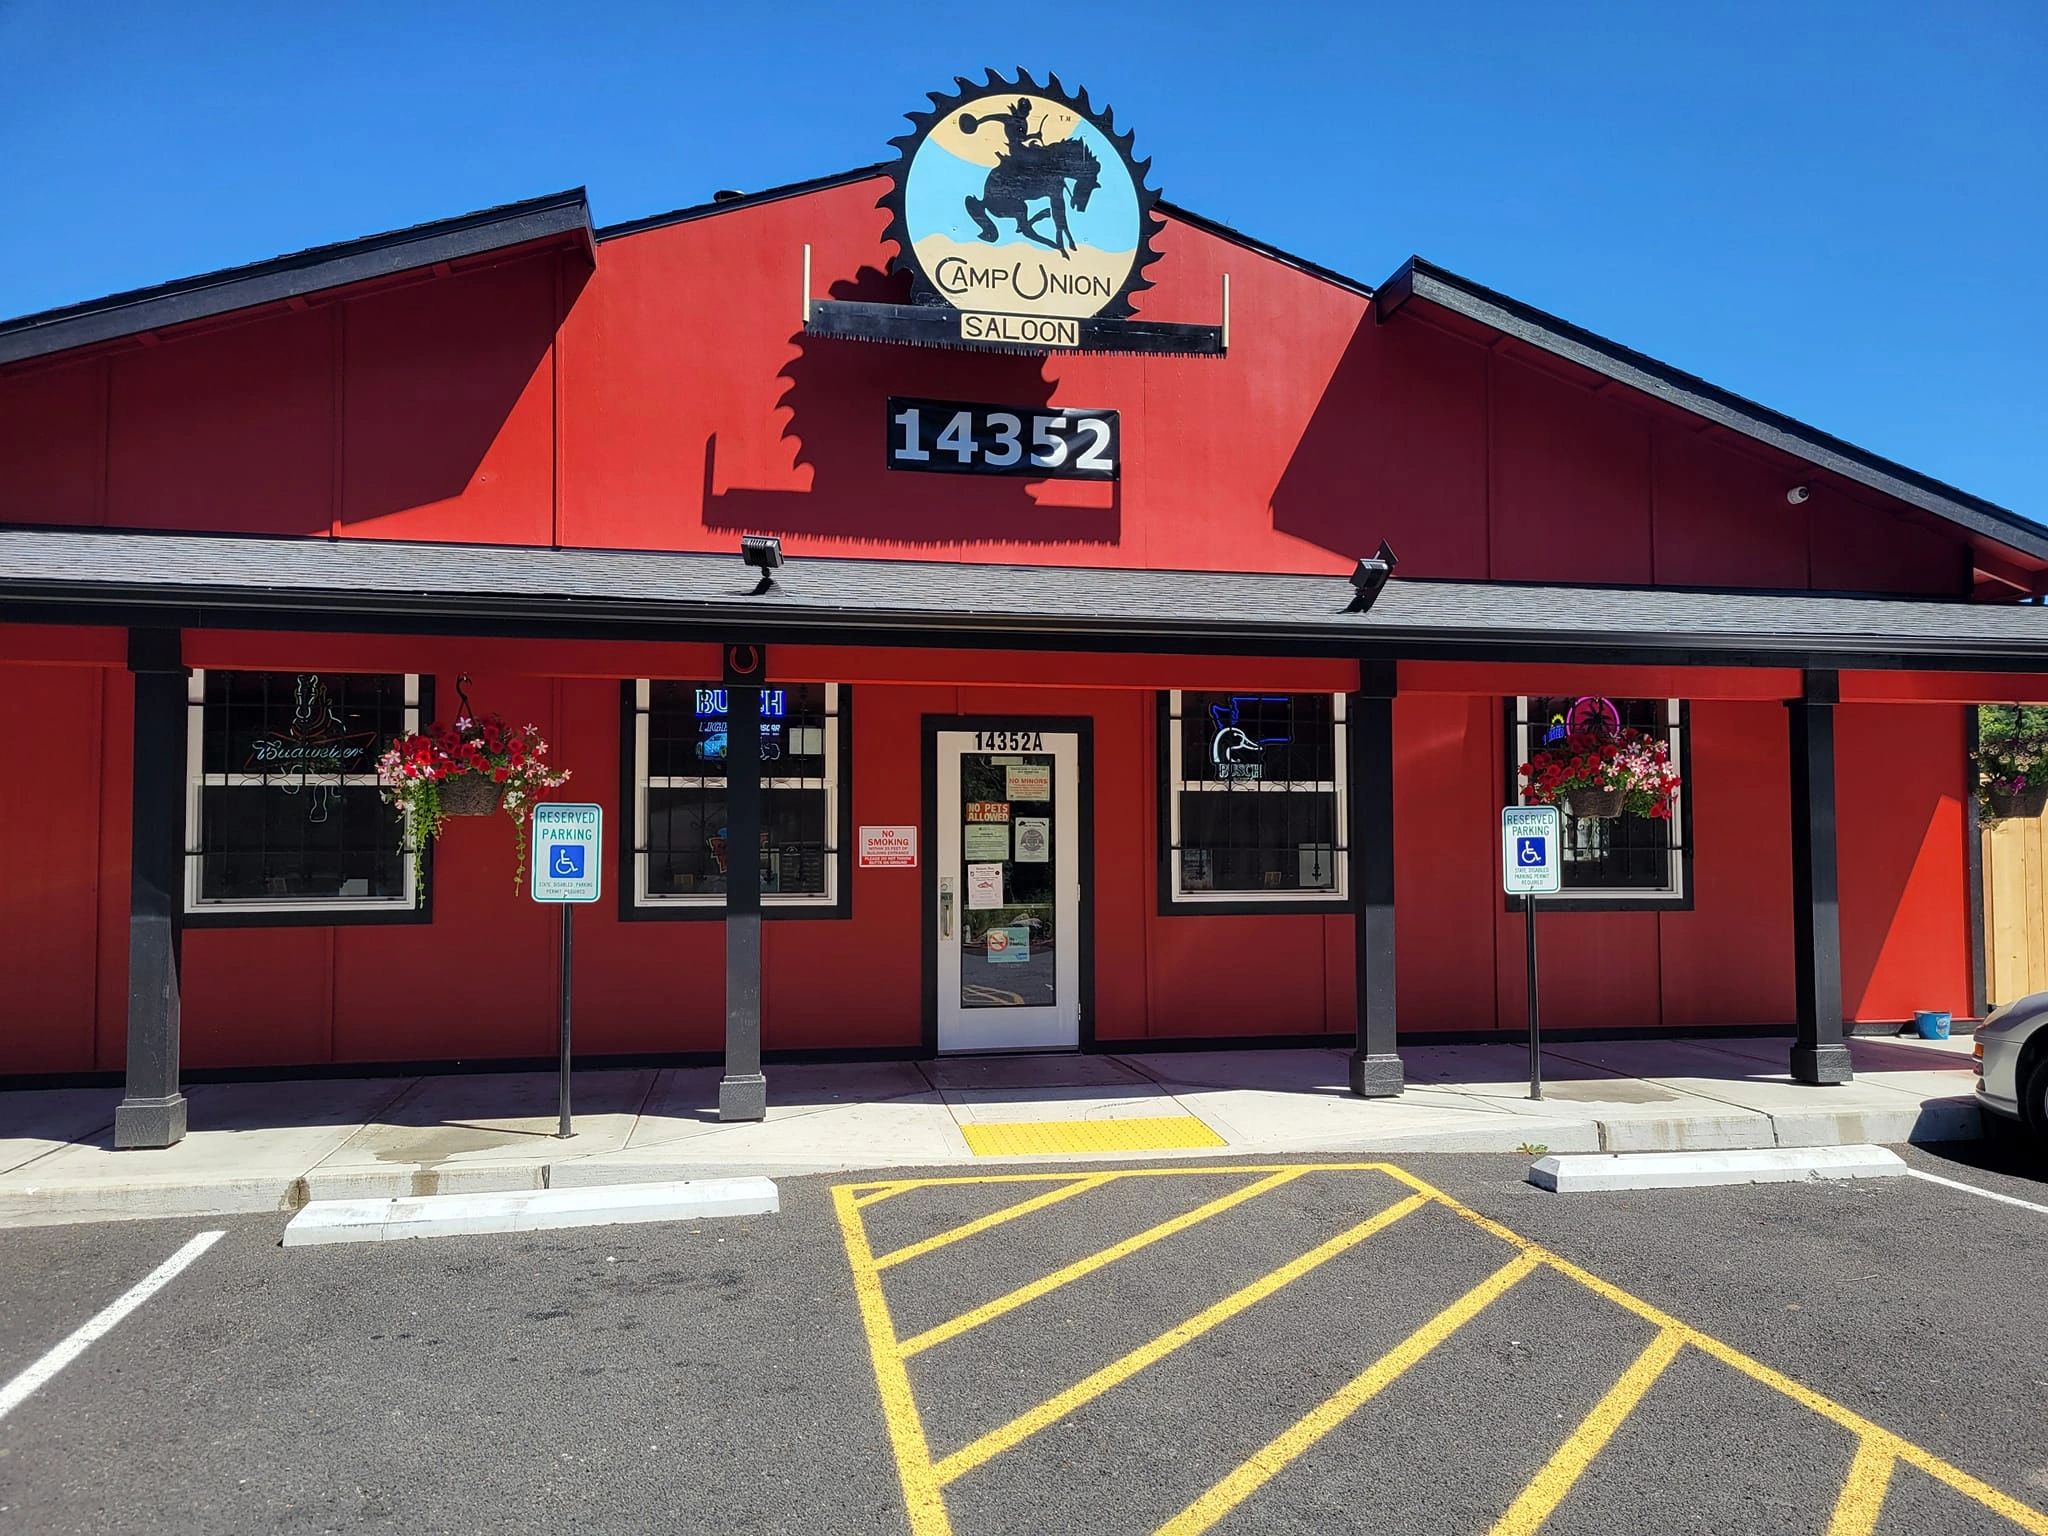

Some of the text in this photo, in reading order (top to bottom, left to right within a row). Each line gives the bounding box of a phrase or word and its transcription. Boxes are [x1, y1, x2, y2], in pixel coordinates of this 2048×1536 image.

[935, 256, 1111, 300] CAMP UNION
[965, 316, 1075, 344] SALOON
[894, 408, 1113, 471] 14352
[695, 689, 783, 715] BUH
[975, 731, 1043, 752] 14352A
[252, 740, 364, 760] Budweiser
[968, 803, 1008, 813] NO PETS
[539, 811, 595, 824] RESERVED
[968, 813, 1008, 822] ALLOWED
[1507, 814, 1554, 825] RESERVED
[542, 828, 592, 840] PARKING
[882, 830, 894, 838] NO
[1512, 826, 1550, 836] PARKING
[867, 838, 909, 846] SMOKING
